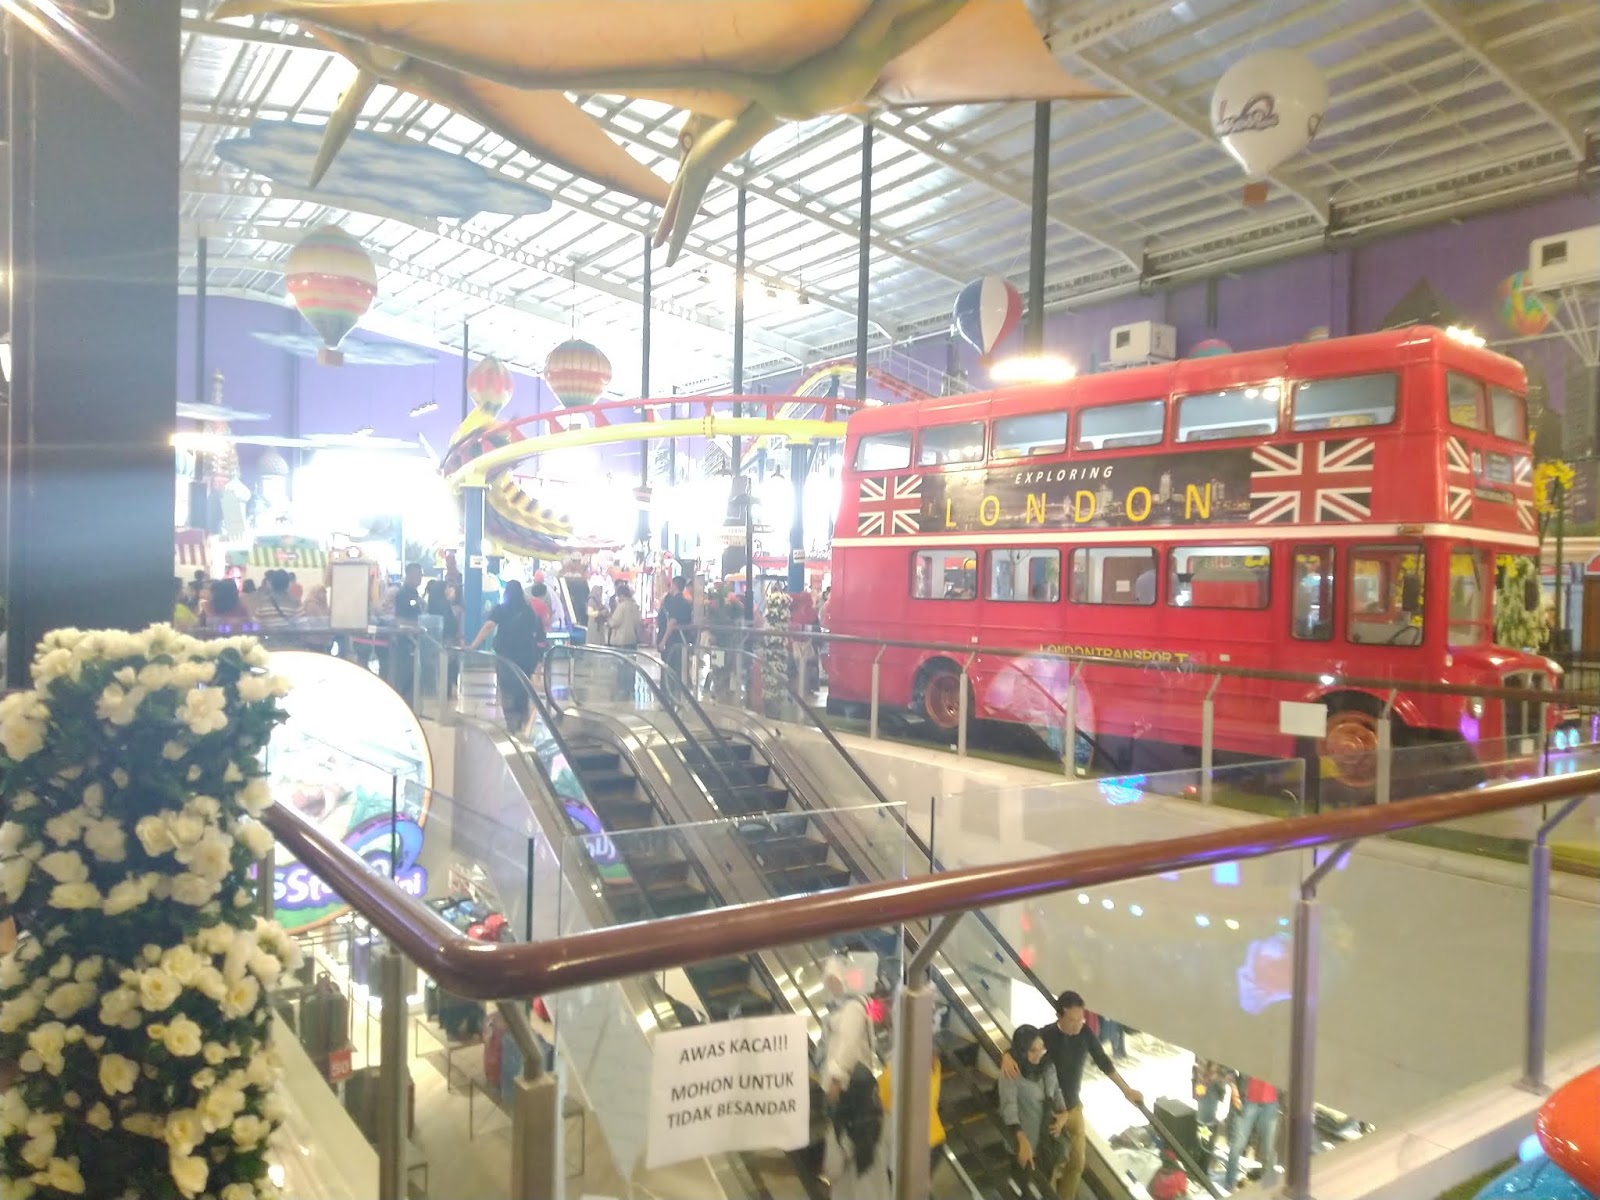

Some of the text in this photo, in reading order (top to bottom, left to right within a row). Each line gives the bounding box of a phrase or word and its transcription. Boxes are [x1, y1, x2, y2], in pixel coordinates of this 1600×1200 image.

[1014, 465, 1113, 484] EXPLORING
[945, 482, 1211, 527] LONDON
[679, 1034, 788, 1065] AWAS KACA!!!
[671, 1071, 794, 1102] MOHON UNTUK
[667, 1099, 796, 1130] TIDAK BESANDAR
